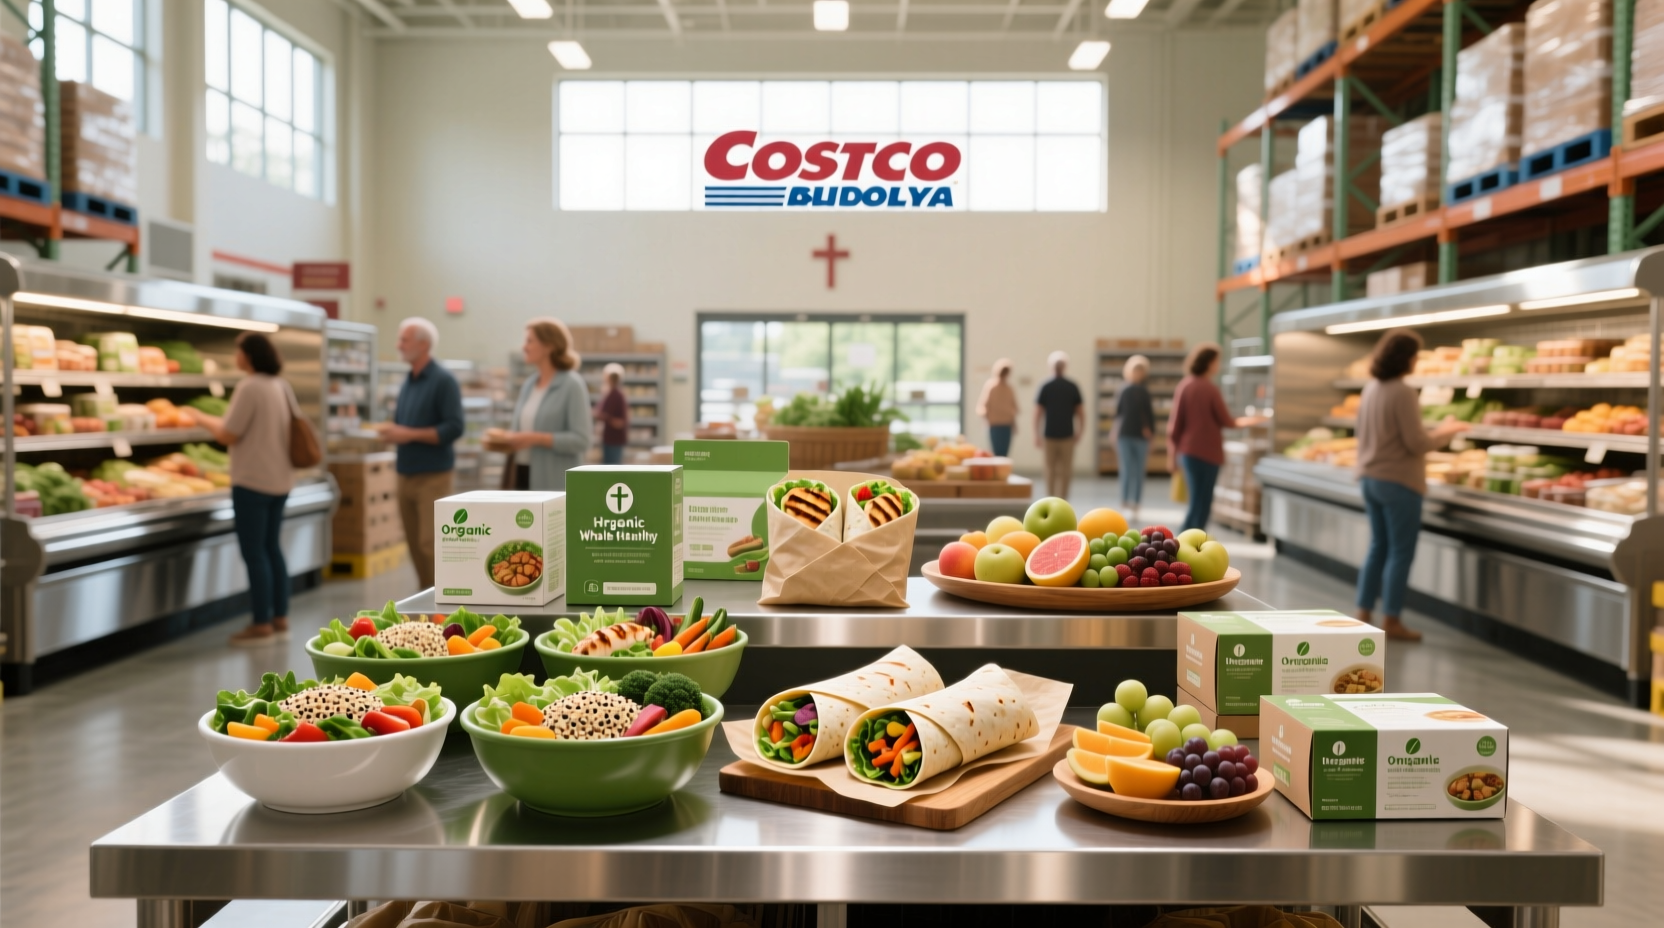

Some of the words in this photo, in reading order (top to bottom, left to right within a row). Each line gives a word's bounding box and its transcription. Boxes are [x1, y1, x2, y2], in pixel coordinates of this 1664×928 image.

[704, 130, 961, 181] COSTCO
[787, 186, 953, 207] BUDOLYA
[441, 523, 492, 537] Organic
